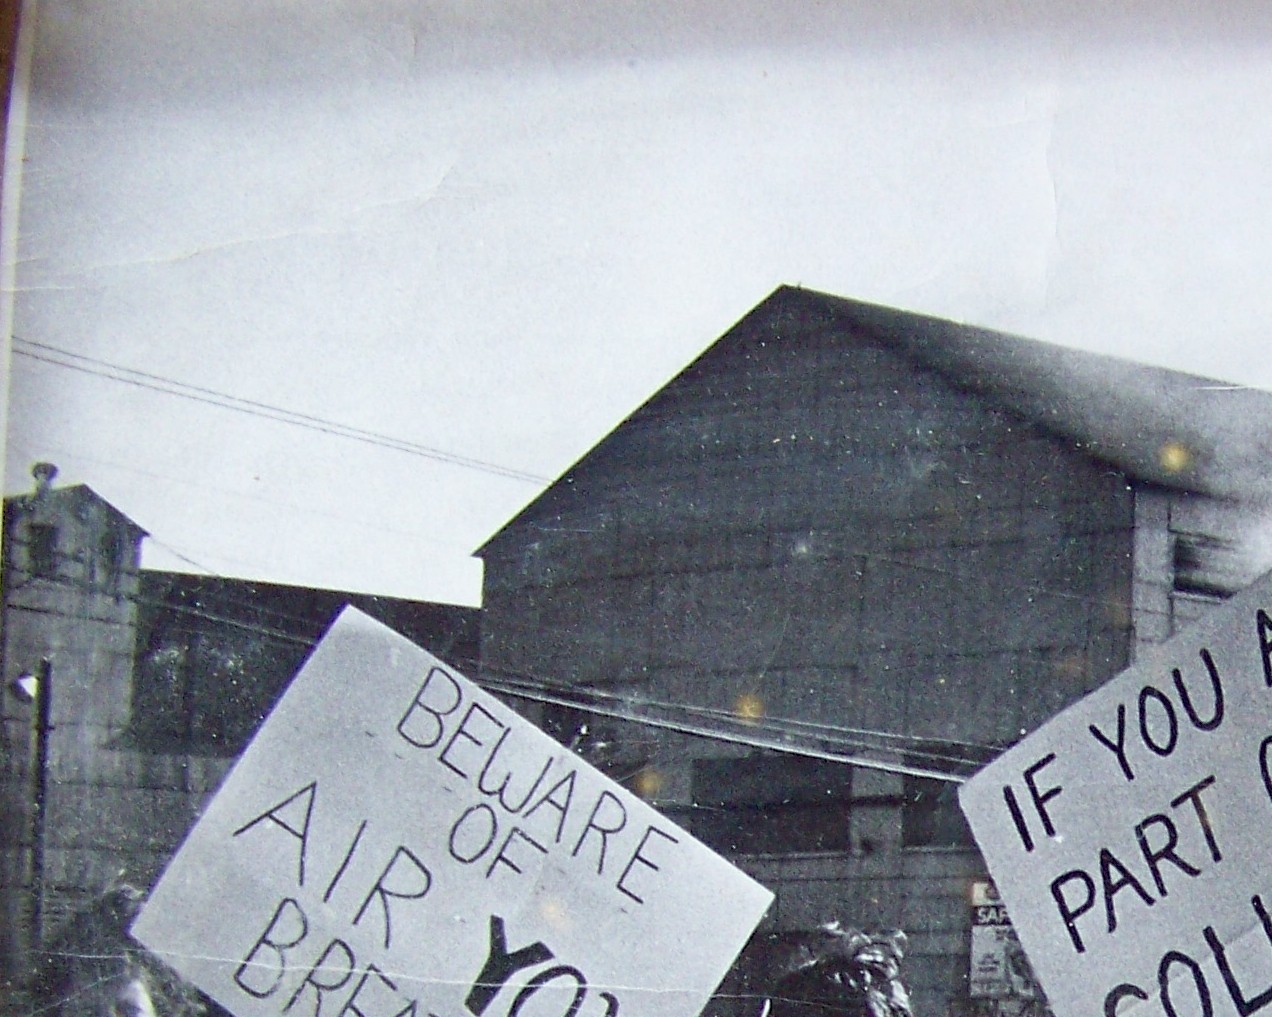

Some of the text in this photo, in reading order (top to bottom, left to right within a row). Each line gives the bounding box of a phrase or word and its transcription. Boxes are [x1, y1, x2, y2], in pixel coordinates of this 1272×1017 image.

[396, 665, 679, 905] BEWARE
[1002, 753, 1064, 852] IF
[1089, 648, 1225, 781] YOU
[232, 780, 432, 949] AIR
[447, 801, 548, 879] OF
[1049, 775, 1223, 954] PART
